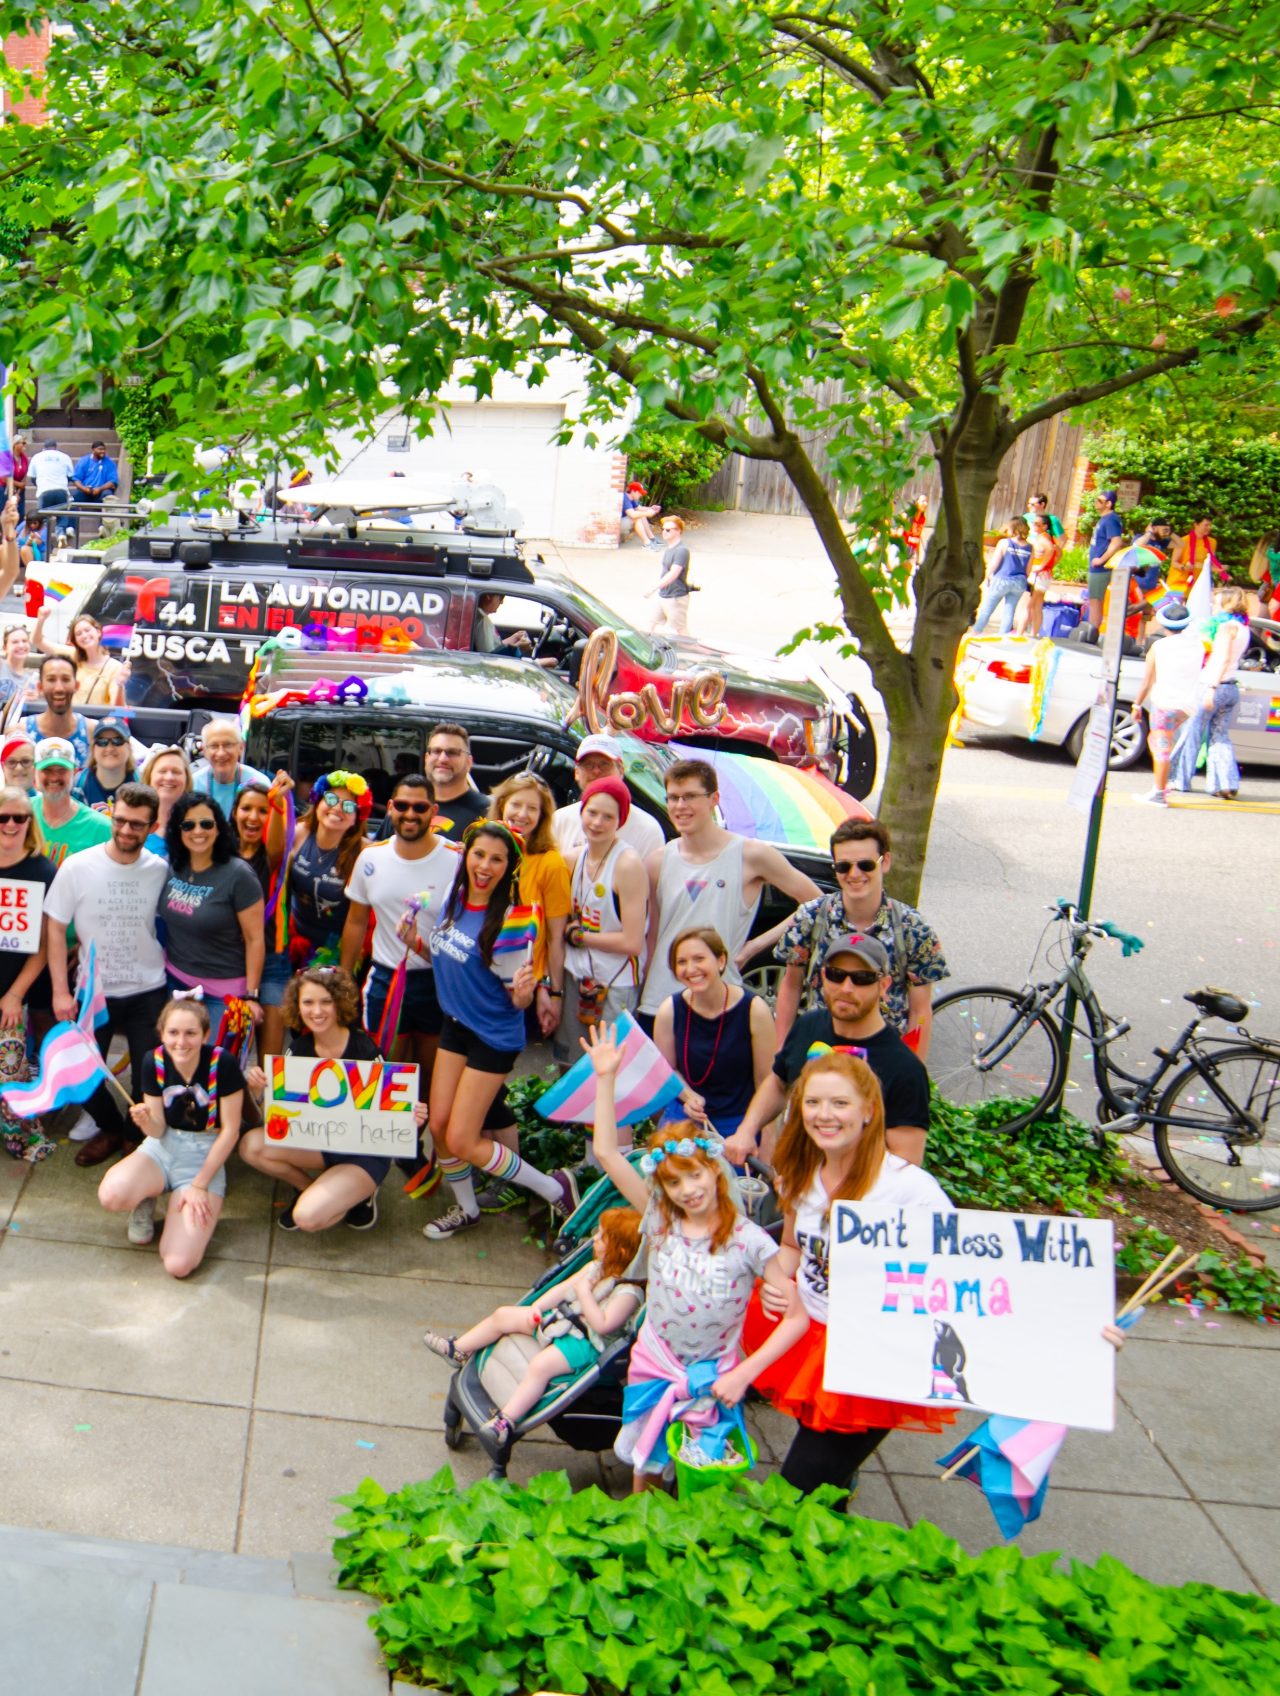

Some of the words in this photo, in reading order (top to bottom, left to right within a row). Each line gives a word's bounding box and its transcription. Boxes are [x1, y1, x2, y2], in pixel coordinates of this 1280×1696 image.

[158, 601, 197, 626] 44
[220, 581, 260, 605] LA
[266, 582, 444, 616] AUTORIDAD
[218, 605, 260, 630] EN
[266, 607, 303, 632] EL
[121, 630, 231, 664] BUSCA
[565, 625, 728, 736] love
[167, 889, 203, 907] TRANS
[168, 877, 215, 898] PROTECT
[167, 900, 194, 917] KIDS
[272, 1056, 418, 1112] LOVE
[360, 1115, 414, 1143] hate
[837, 1205, 908, 1249] Don't
[932, 1212, 1004, 1259] Mess
[1013, 1218, 1095, 1268] With
[881, 1261, 1013, 1317] Mama
